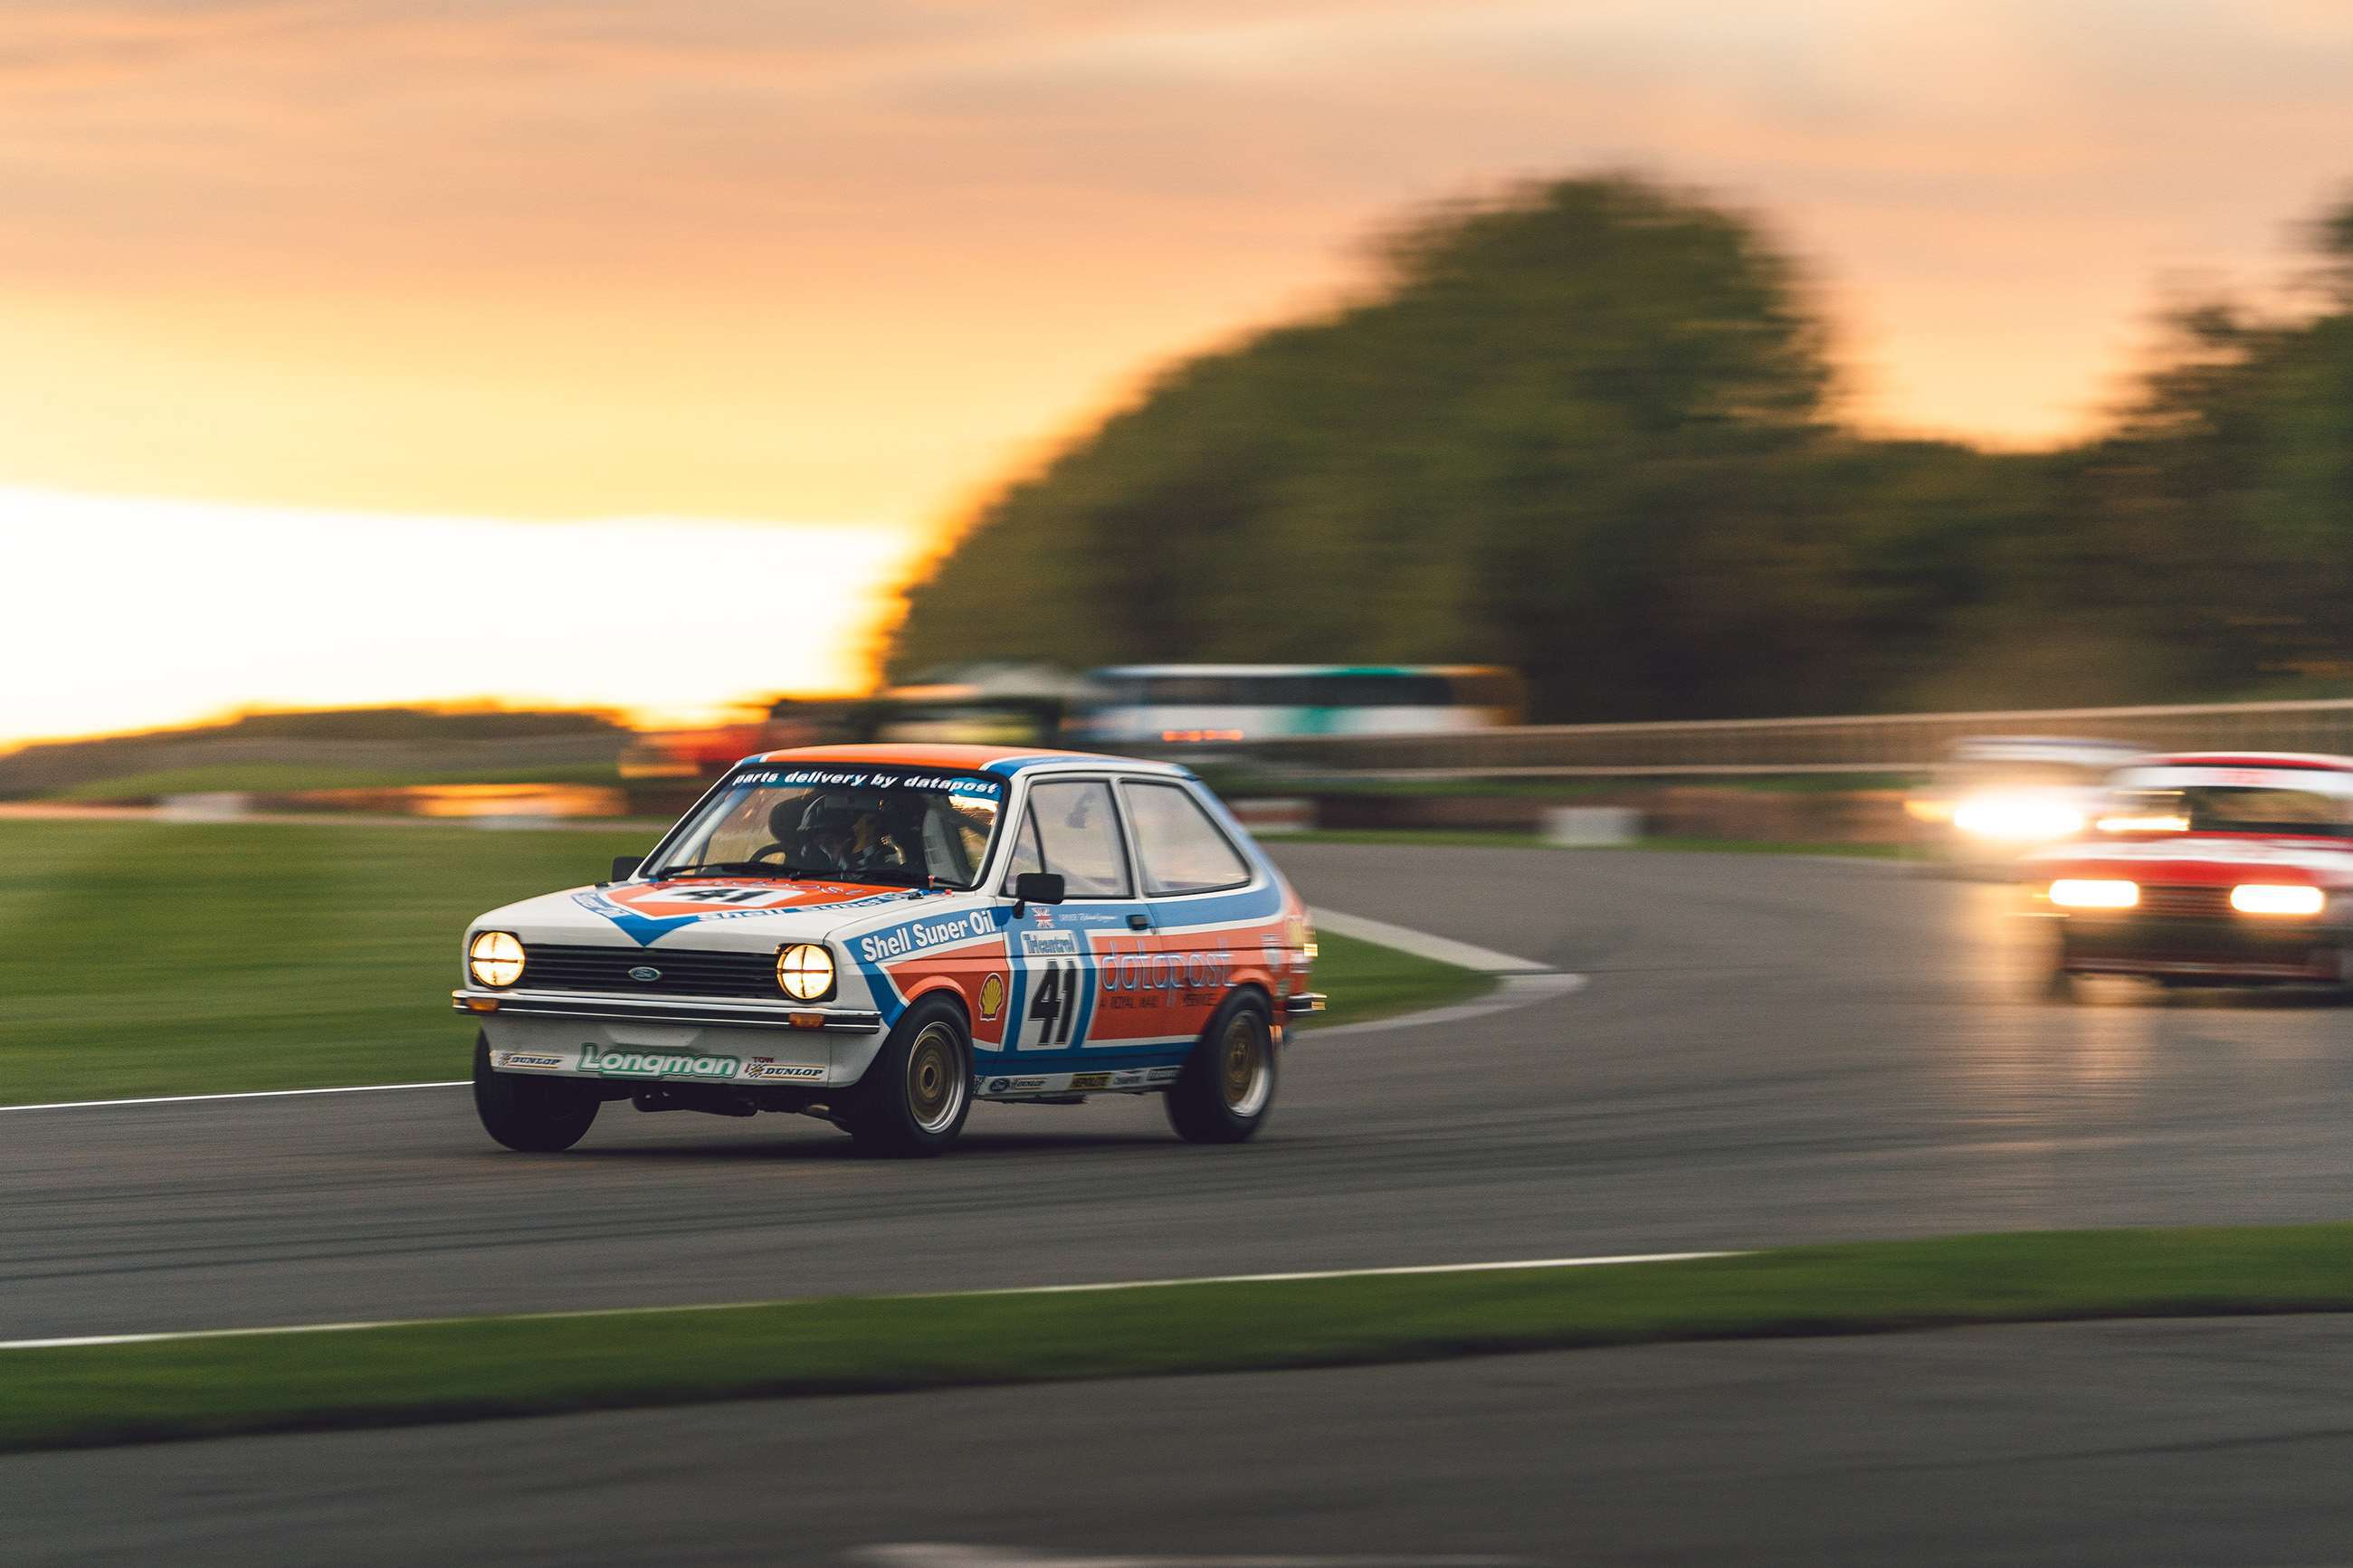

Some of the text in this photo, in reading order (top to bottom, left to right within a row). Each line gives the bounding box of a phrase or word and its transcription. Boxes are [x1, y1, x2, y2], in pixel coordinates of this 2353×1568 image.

[732, 771, 999, 794] parts delivery by datapost
[673, 888, 775, 903] 41
[861, 909, 996, 962] Shell Super Oil
[1101, 937, 1239, 1007] datapost
[1028, 958, 1077, 1046] 41
[510, 1056, 561, 1066] DUNLOP
[577, 1042, 738, 1078] Longman
[765, 1068, 824, 1077] DUNLOP
